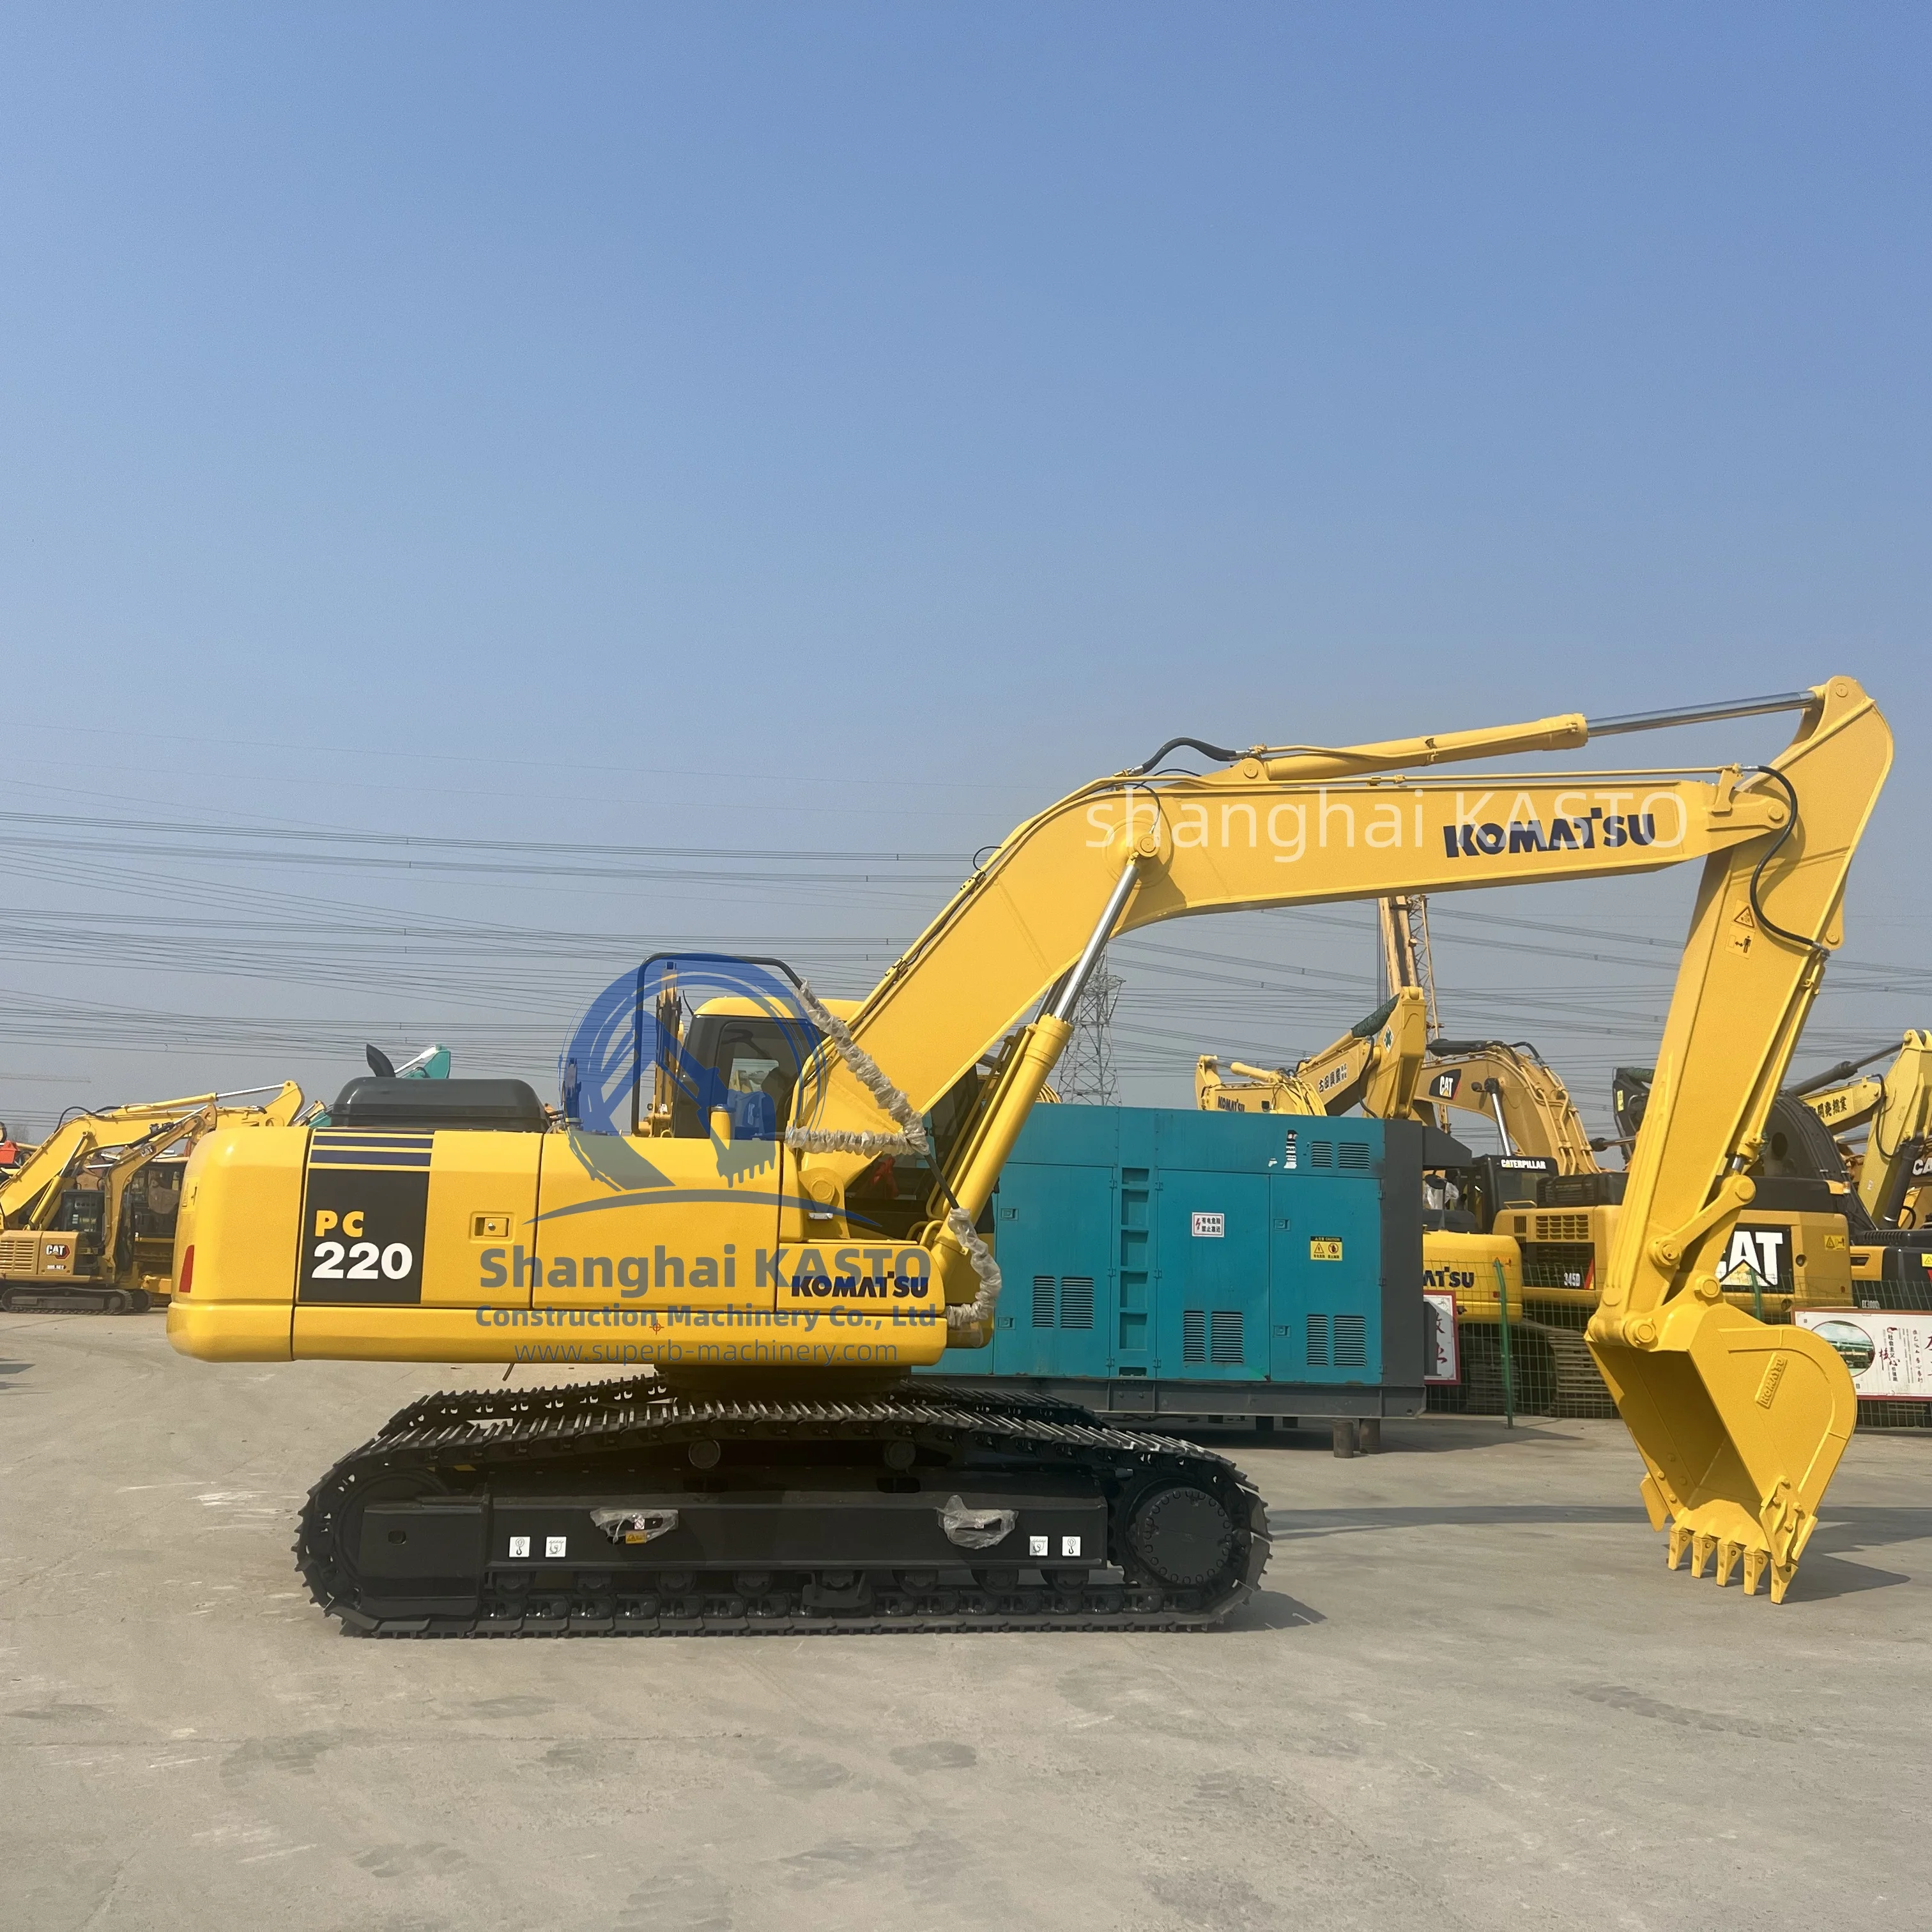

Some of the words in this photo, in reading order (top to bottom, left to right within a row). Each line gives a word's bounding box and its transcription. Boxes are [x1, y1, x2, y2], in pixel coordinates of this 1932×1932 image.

[1443, 807, 1656, 858] KOMATSU
[1439, 1076, 1453, 1097] CAT
[1217, 1095, 1245, 1112] KOMATSU
[1501, 1159, 1546, 1169] CATERPILLAR
[314, 1209, 365, 1238] PC
[46, 1245, 65, 1256] CAT
[311, 1241, 413, 1280] 220
[791, 1271, 930, 1298] KOMATSU
